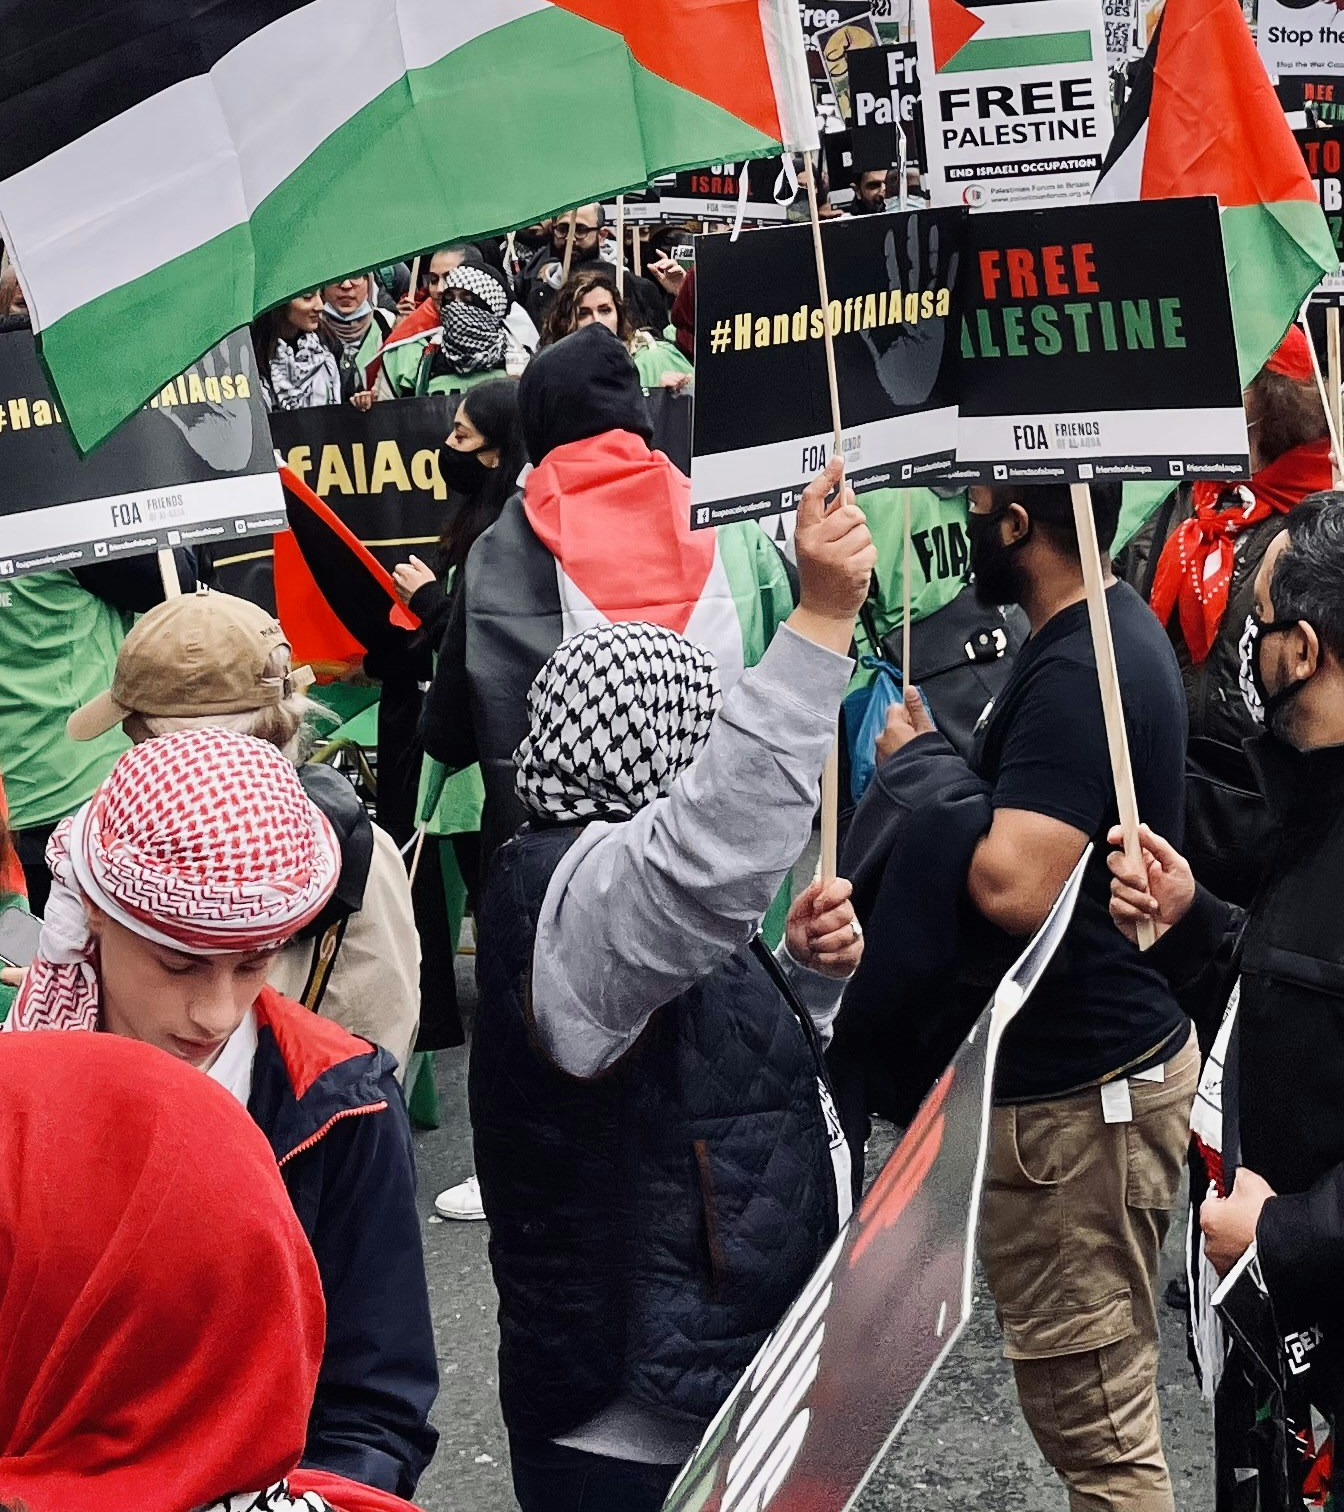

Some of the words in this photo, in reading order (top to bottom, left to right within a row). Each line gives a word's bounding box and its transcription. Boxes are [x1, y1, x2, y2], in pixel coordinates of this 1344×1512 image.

[1268, 26, 1313, 47] Stop
[938, 77, 1095, 122] FREE
[942, 117, 1097, 150] PALESTINE
[949, 167, 974, 179] END
[976, 163, 1019, 177] ISRAELI
[1022, 156, 1097, 173] OCCUPATION
[978, 243, 1100, 301] FREE
[709, 287, 951, 355] #HandsOffAlAqsa
[960, 297, 1188, 359] ALESTINE
[1013, 424, 1049, 451] FOA
[1054, 421, 1100, 438] FRIENDS
[801, 444, 826, 475] FOA
[110, 501, 143, 529] FOA
[146, 494, 185, 512] FRIENDS
[911, 521, 970, 584] FOA
